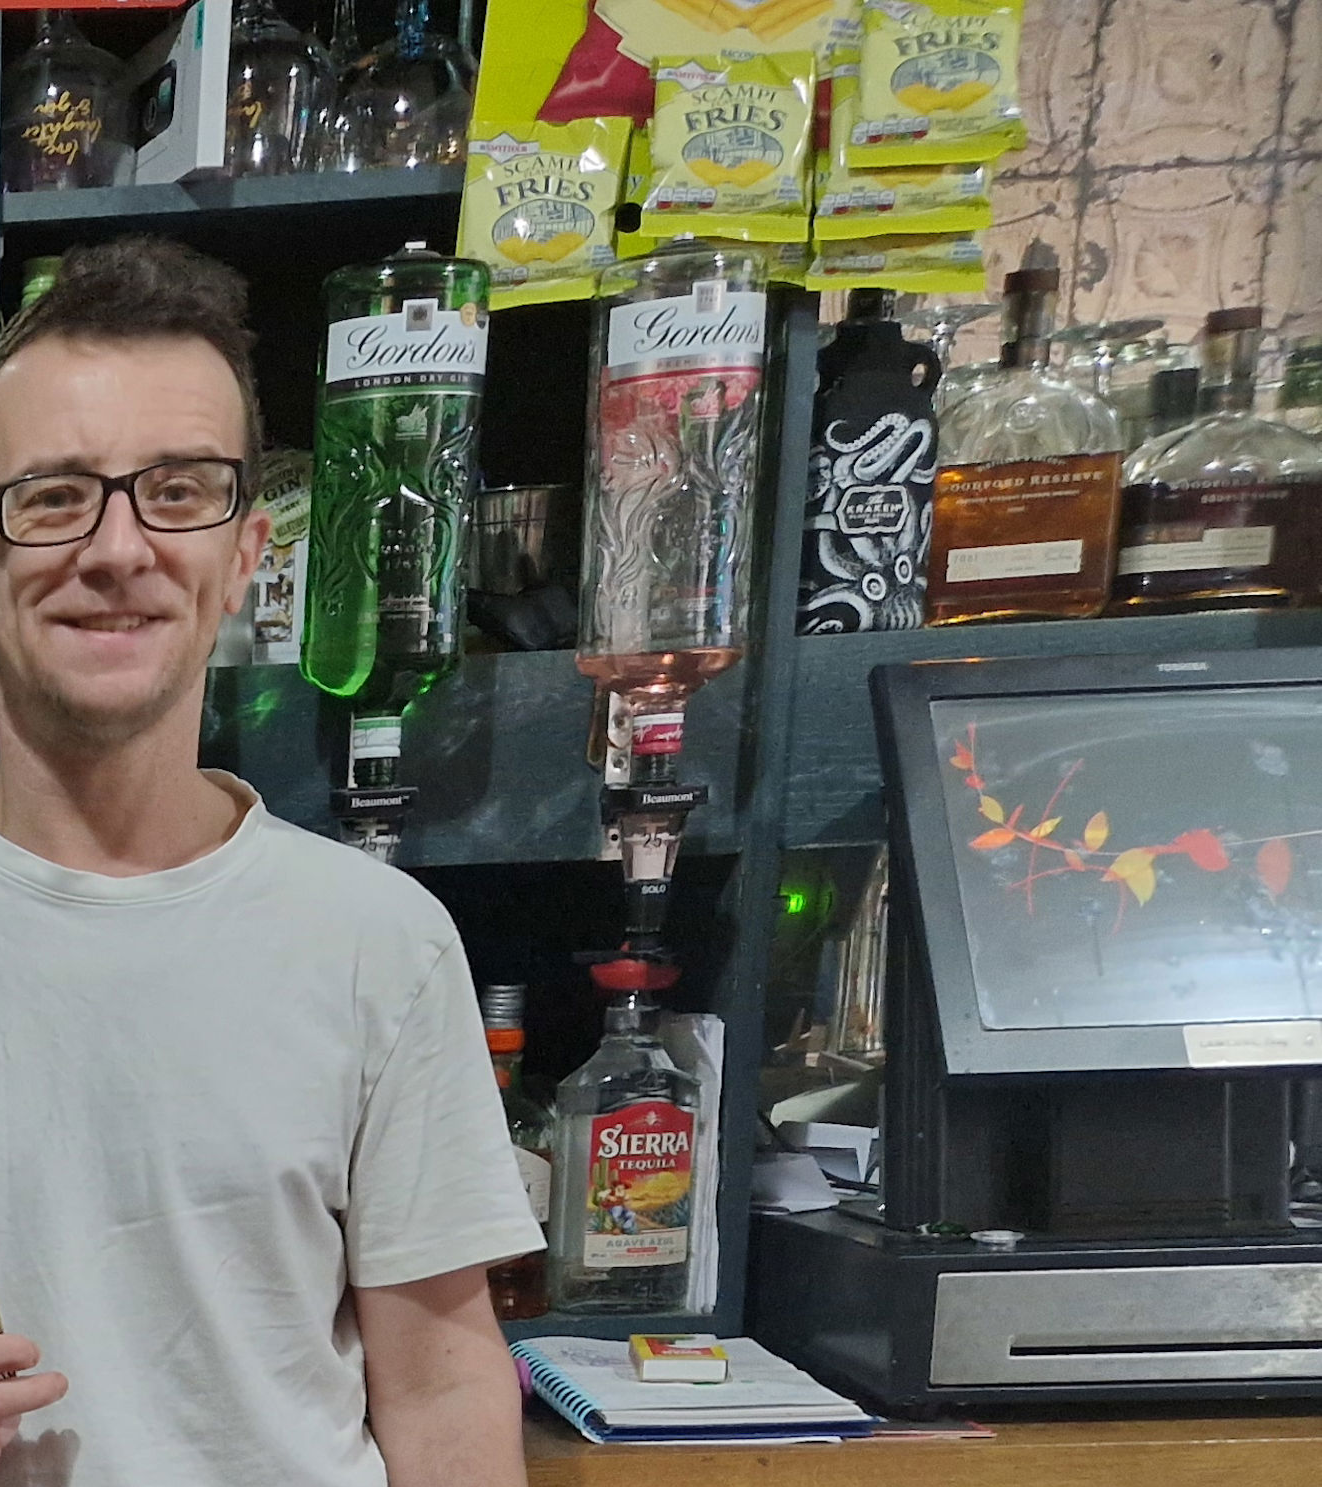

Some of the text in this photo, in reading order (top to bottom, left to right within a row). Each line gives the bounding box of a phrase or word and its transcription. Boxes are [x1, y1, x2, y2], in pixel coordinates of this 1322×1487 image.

[893, 30, 1001, 56] FRIES
[692, 85, 776, 103] SCAMPI
[684, 103, 788, 133] FRIES
[504, 155, 579, 176] SCAMP
[495, 175, 595, 207] FRIES
[634, 304, 760, 354] Gordon's
[346, 324, 476, 370] Gordon's
[354, 373, 469, 388] LONDON DRY GIN
[1030, 471, 1104, 486] RESERVE
[264, 477, 302, 501] GIN
[351, 796, 403, 808] Beaumont
[643, 791, 693, 805] Beaumont
[642, 884, 666, 894] SOLO
[597, 1123, 690, 1159] SIERRA
[618, 1159, 676, 1171] TEQUILA
[606, 1238, 645, 1249] AGAVE
